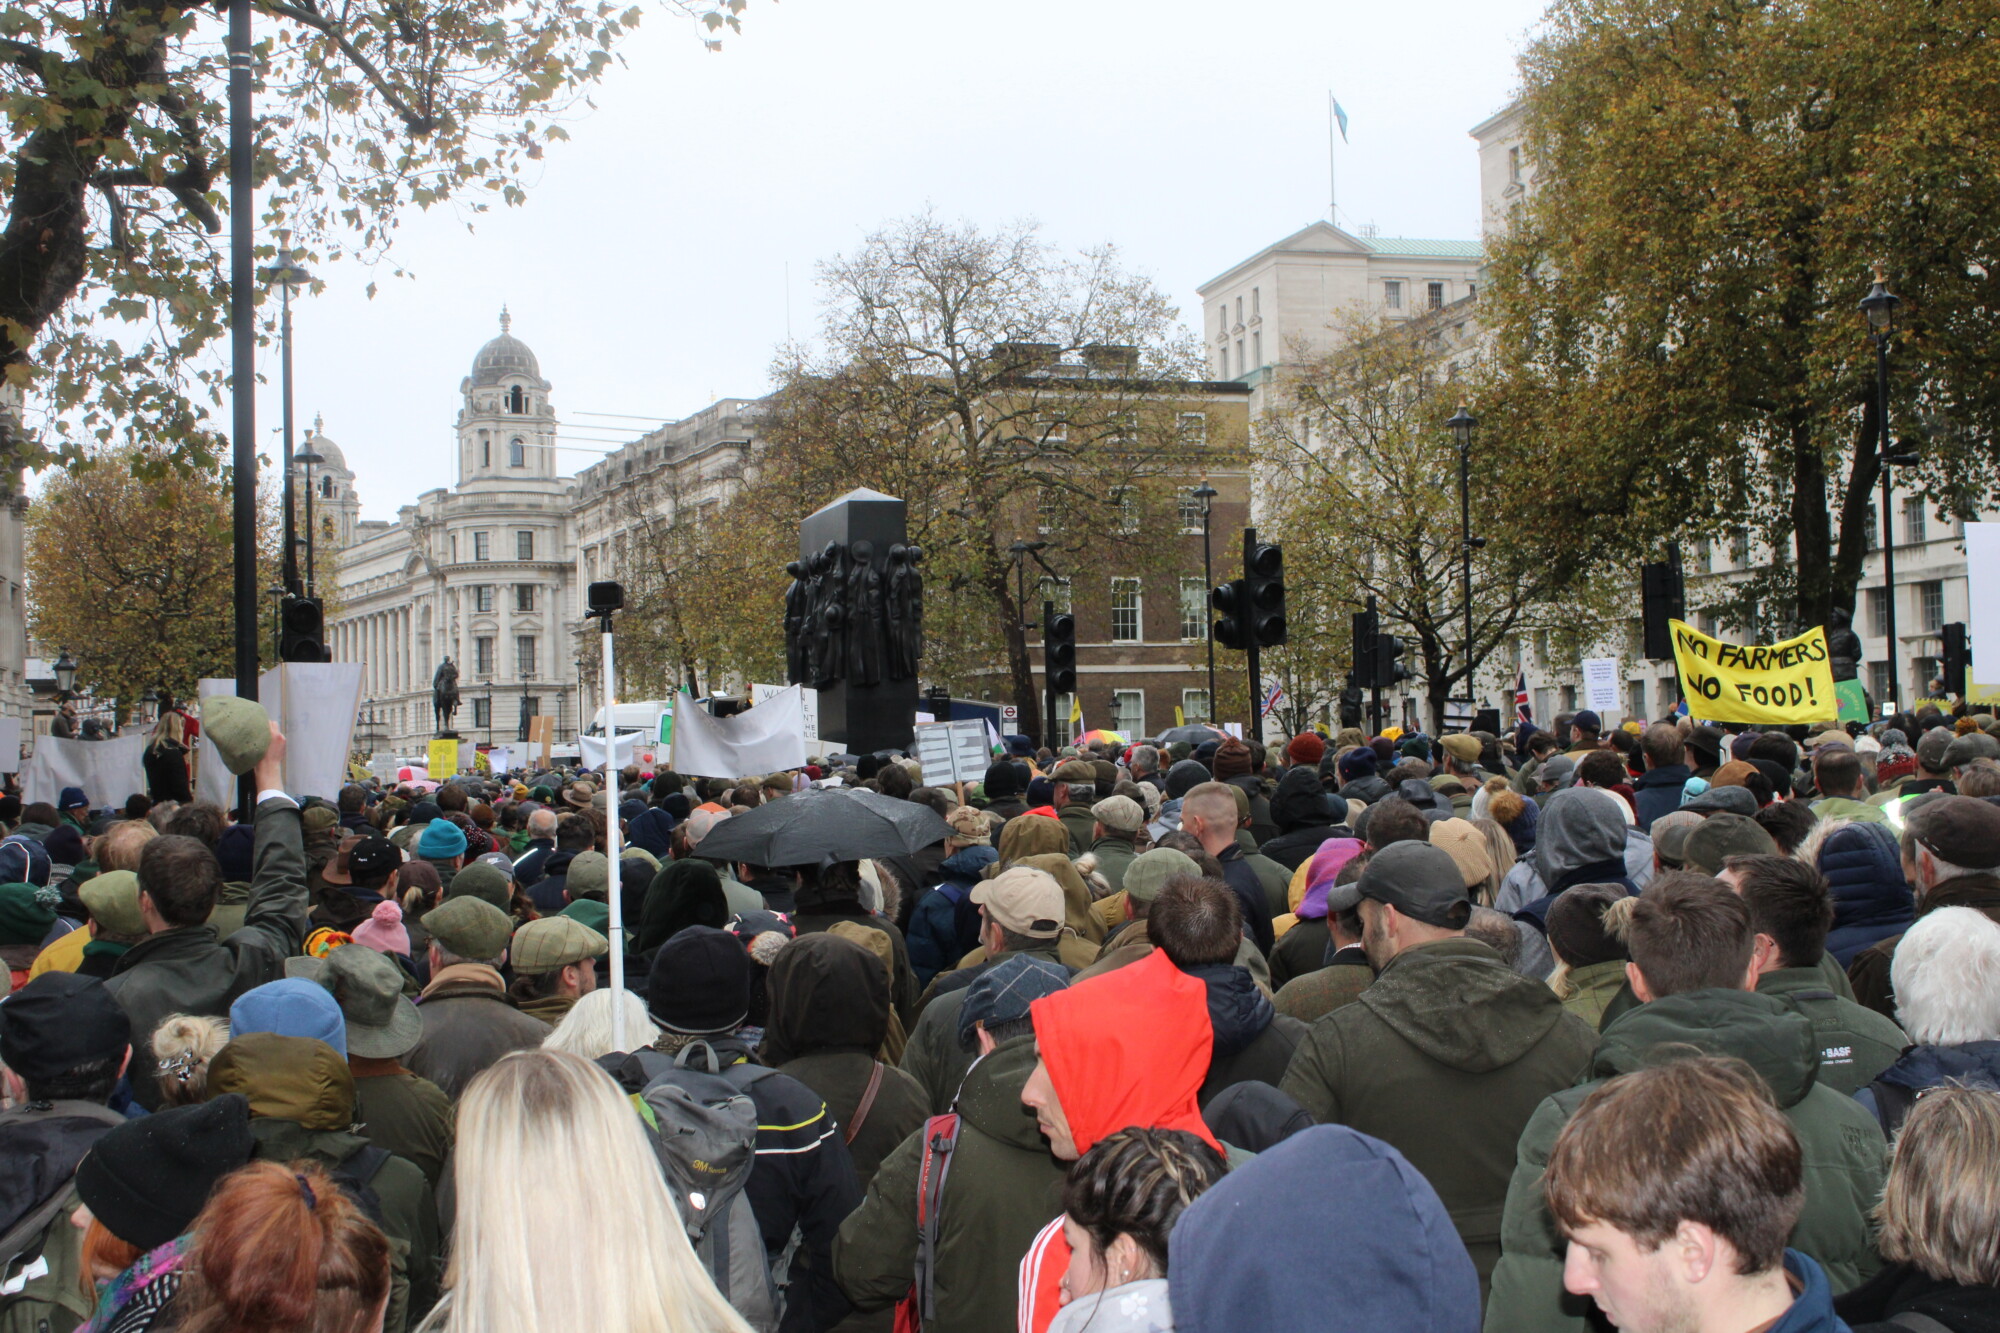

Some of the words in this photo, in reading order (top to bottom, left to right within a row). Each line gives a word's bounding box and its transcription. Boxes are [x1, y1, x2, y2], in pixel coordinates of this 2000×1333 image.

[1677, 629, 1708, 659] NO
[1717, 638, 1827, 670] FARMERS
[1686, 673, 1721, 700] NO
[1735, 677, 1817, 707] FOOD!
[1826, 1046, 1851, 1058] BASF
